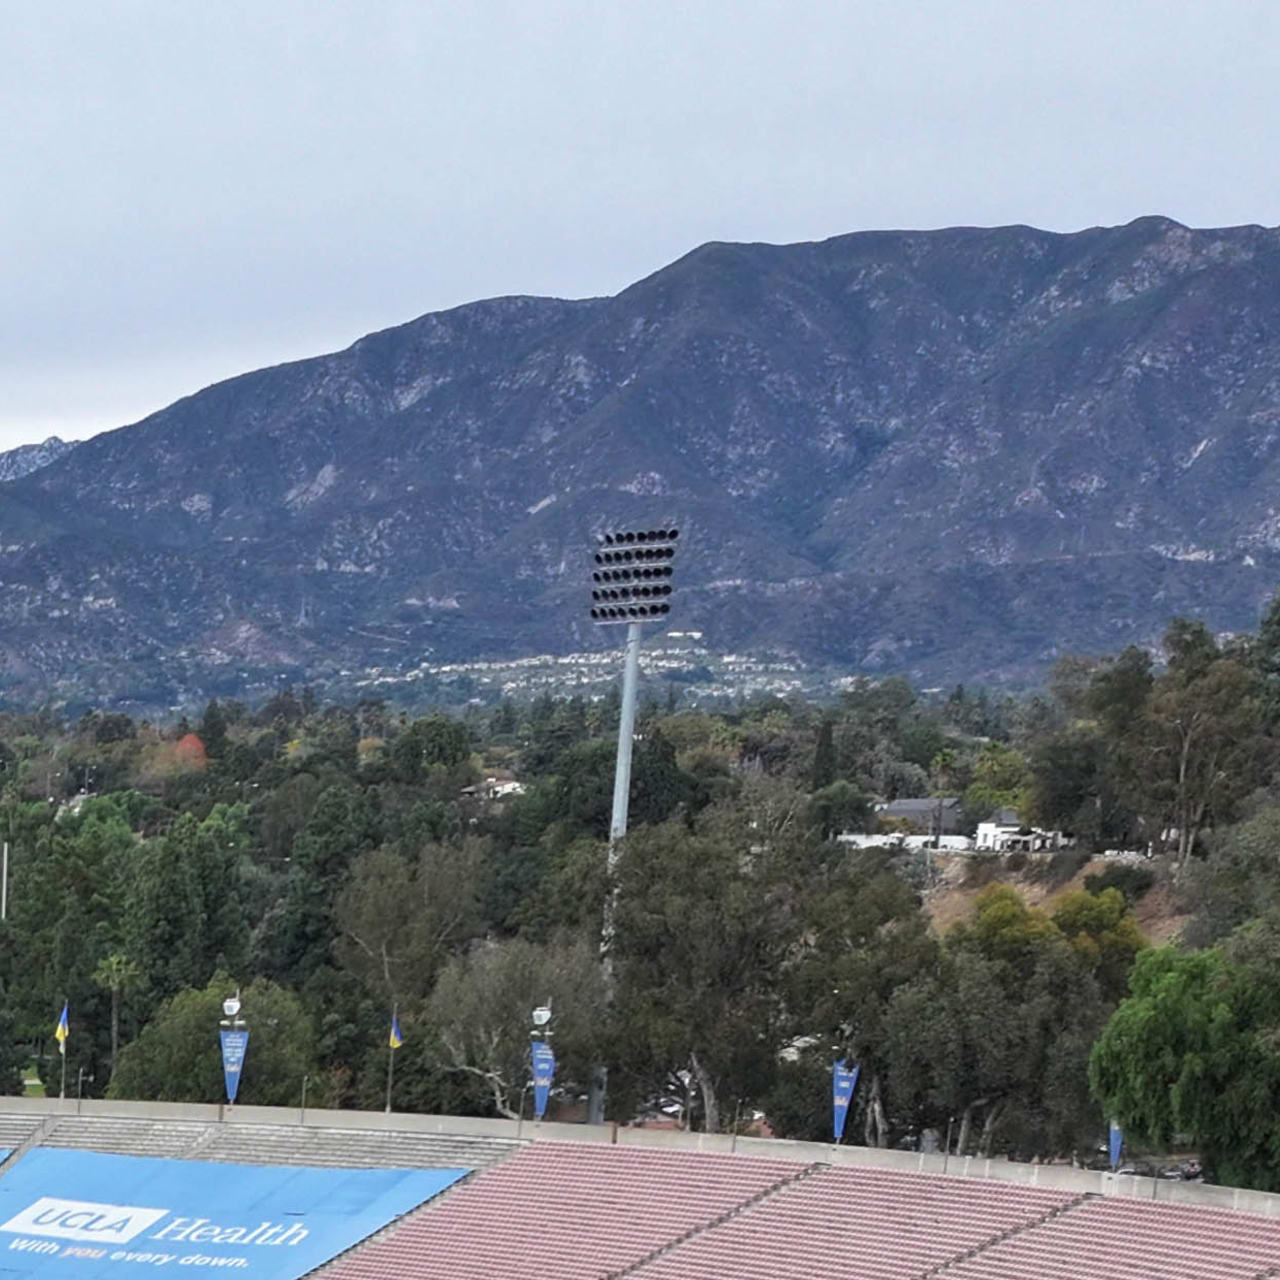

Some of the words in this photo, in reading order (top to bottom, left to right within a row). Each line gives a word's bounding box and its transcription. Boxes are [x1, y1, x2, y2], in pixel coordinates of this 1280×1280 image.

[31, 1207, 130, 1235] UCLA
[149, 1215, 310, 1247] Health
[7, 1237, 60, 1256] With
[61, 1244, 108, 1261] you
[110, 1250, 174, 1267] every
[178, 1254, 249, 1269] down.
